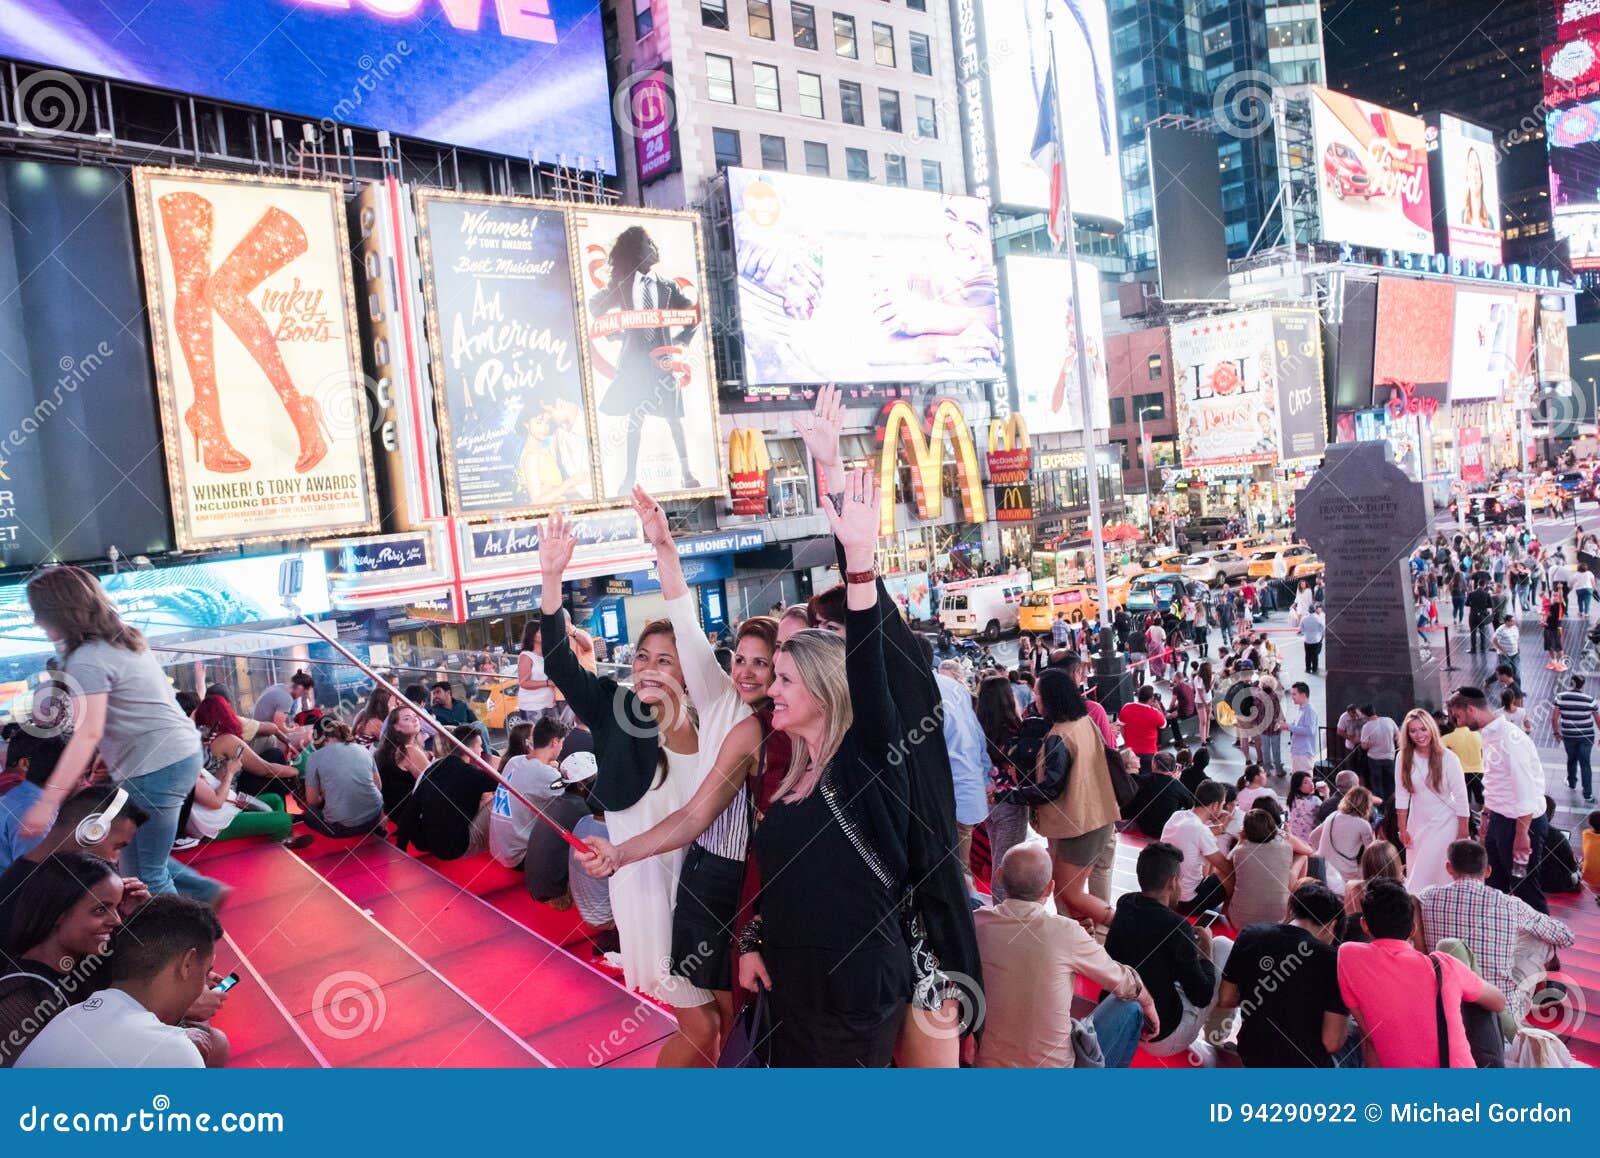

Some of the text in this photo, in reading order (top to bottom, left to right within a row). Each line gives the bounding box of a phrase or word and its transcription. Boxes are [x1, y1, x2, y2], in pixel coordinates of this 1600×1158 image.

[641, 121, 665, 142] OPEN
[646, 135, 664, 159] 24
[642, 151, 671, 175] HOURS
[460, 209, 538, 238] Winner!
[479, 238, 499, 249] TONY
[502, 239, 533, 250] AWARDS
[452, 255, 555, 275] Best Musical!
[1386, 248, 1561, 290] 1540 BROADWAY
[472, 279, 504, 326] An
[274, 316, 341, 342] Boots
[593, 311, 660, 334] FINAL MONTHS
[452, 312, 572, 374] American
[474, 358, 545, 401] Paris
[1288, 386, 1313, 416] CATS
[1040, 452, 1084, 468] EXPRESS
[192, 474, 358, 500] WINNER! 6 TONY AWARDS
[195, 491, 359, 512] INCLUDING BEST MUSICAL
[484, 533, 503, 556] An
[695, 538, 734, 553] MONEY
[740, 534, 762, 546] ATM
[379, 547, 405, 565] Paris
[606, 587, 632, 595] EXCHANGE
